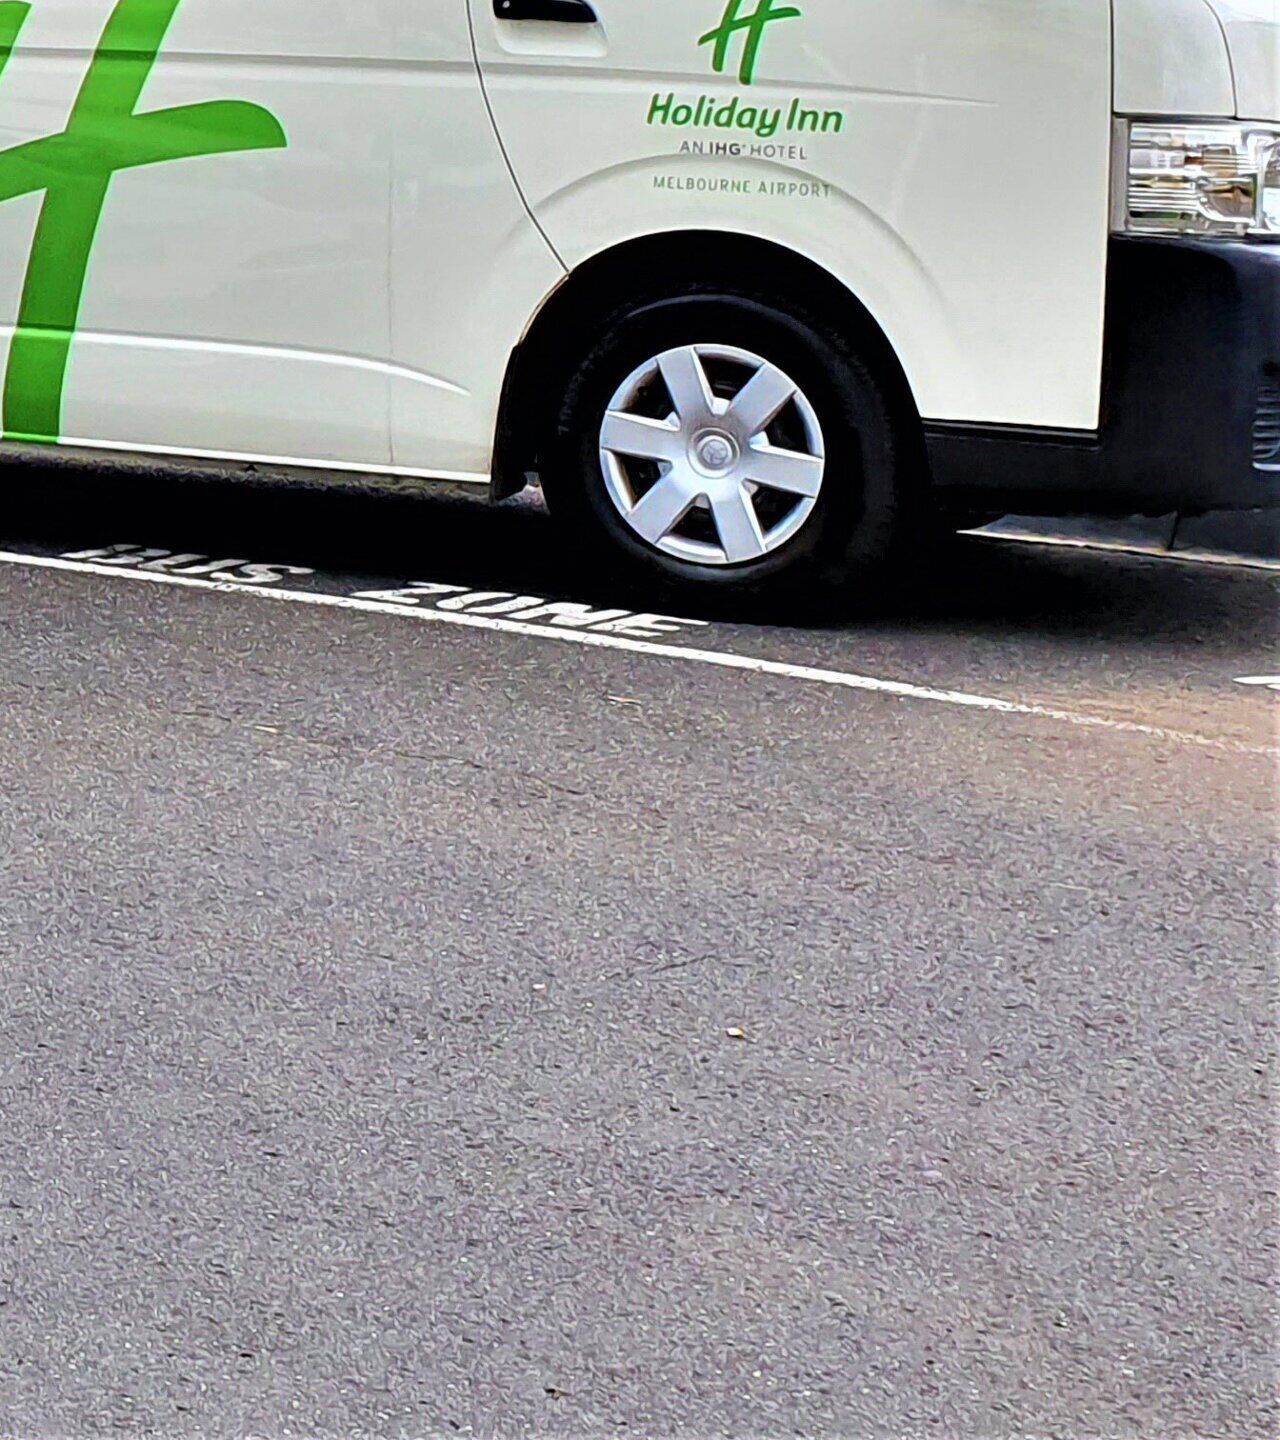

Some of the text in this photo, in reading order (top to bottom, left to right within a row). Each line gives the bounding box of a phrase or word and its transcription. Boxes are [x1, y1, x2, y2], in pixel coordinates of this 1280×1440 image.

[646, 92, 844, 138] Holiday Inn
[679, 140, 704, 155] AN
[749, 143, 808, 160] HOTEL
[653, 174, 832, 198] MELBOURNE AIRPORT
[59, 543, 710, 638] BUS ZONE
